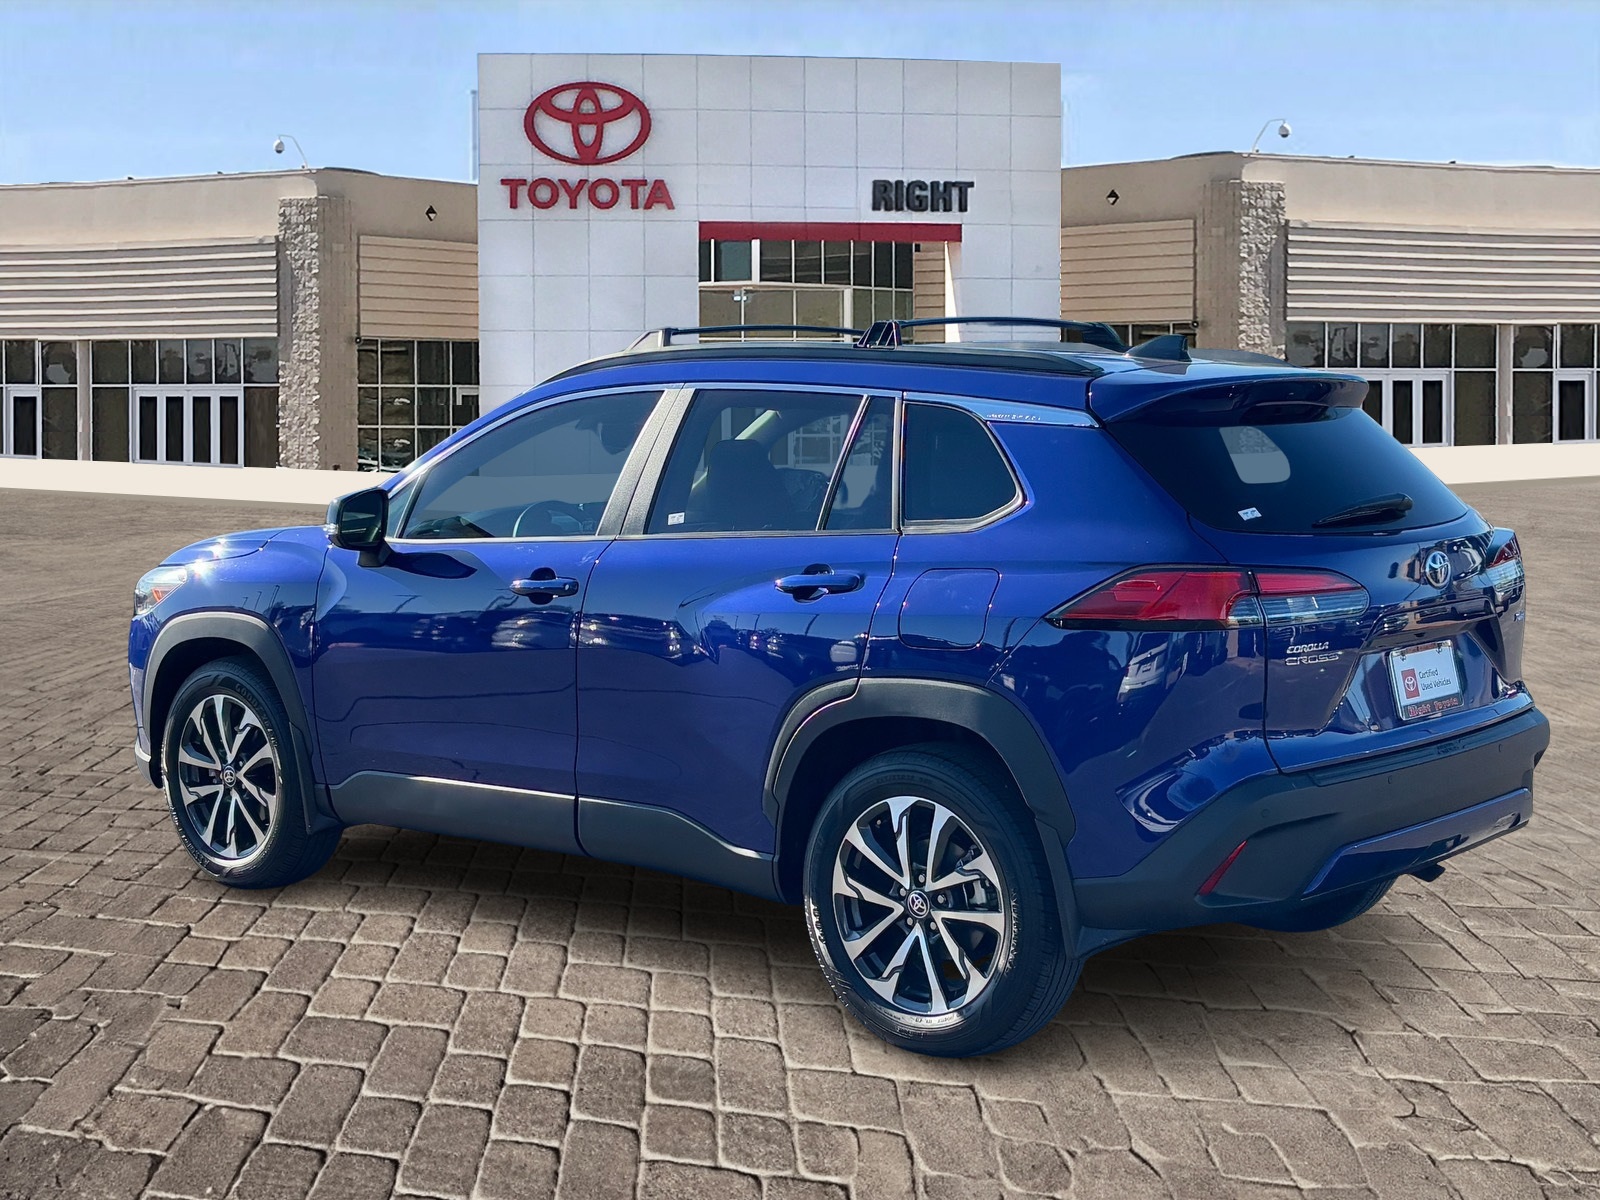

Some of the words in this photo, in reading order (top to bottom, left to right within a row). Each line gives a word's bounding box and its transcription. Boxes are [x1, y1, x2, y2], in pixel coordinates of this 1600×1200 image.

[500, 177, 676, 210] TOYOTA
[872, 179, 975, 213] RIGHT
[1286, 641, 1330, 655] COROLLA
[1285, 652, 1341, 666] CROSS
[1418, 668, 1439, 679] Certified
[1421, 682, 1433, 691] Used
[1433, 677, 1452, 688] Vehicles
